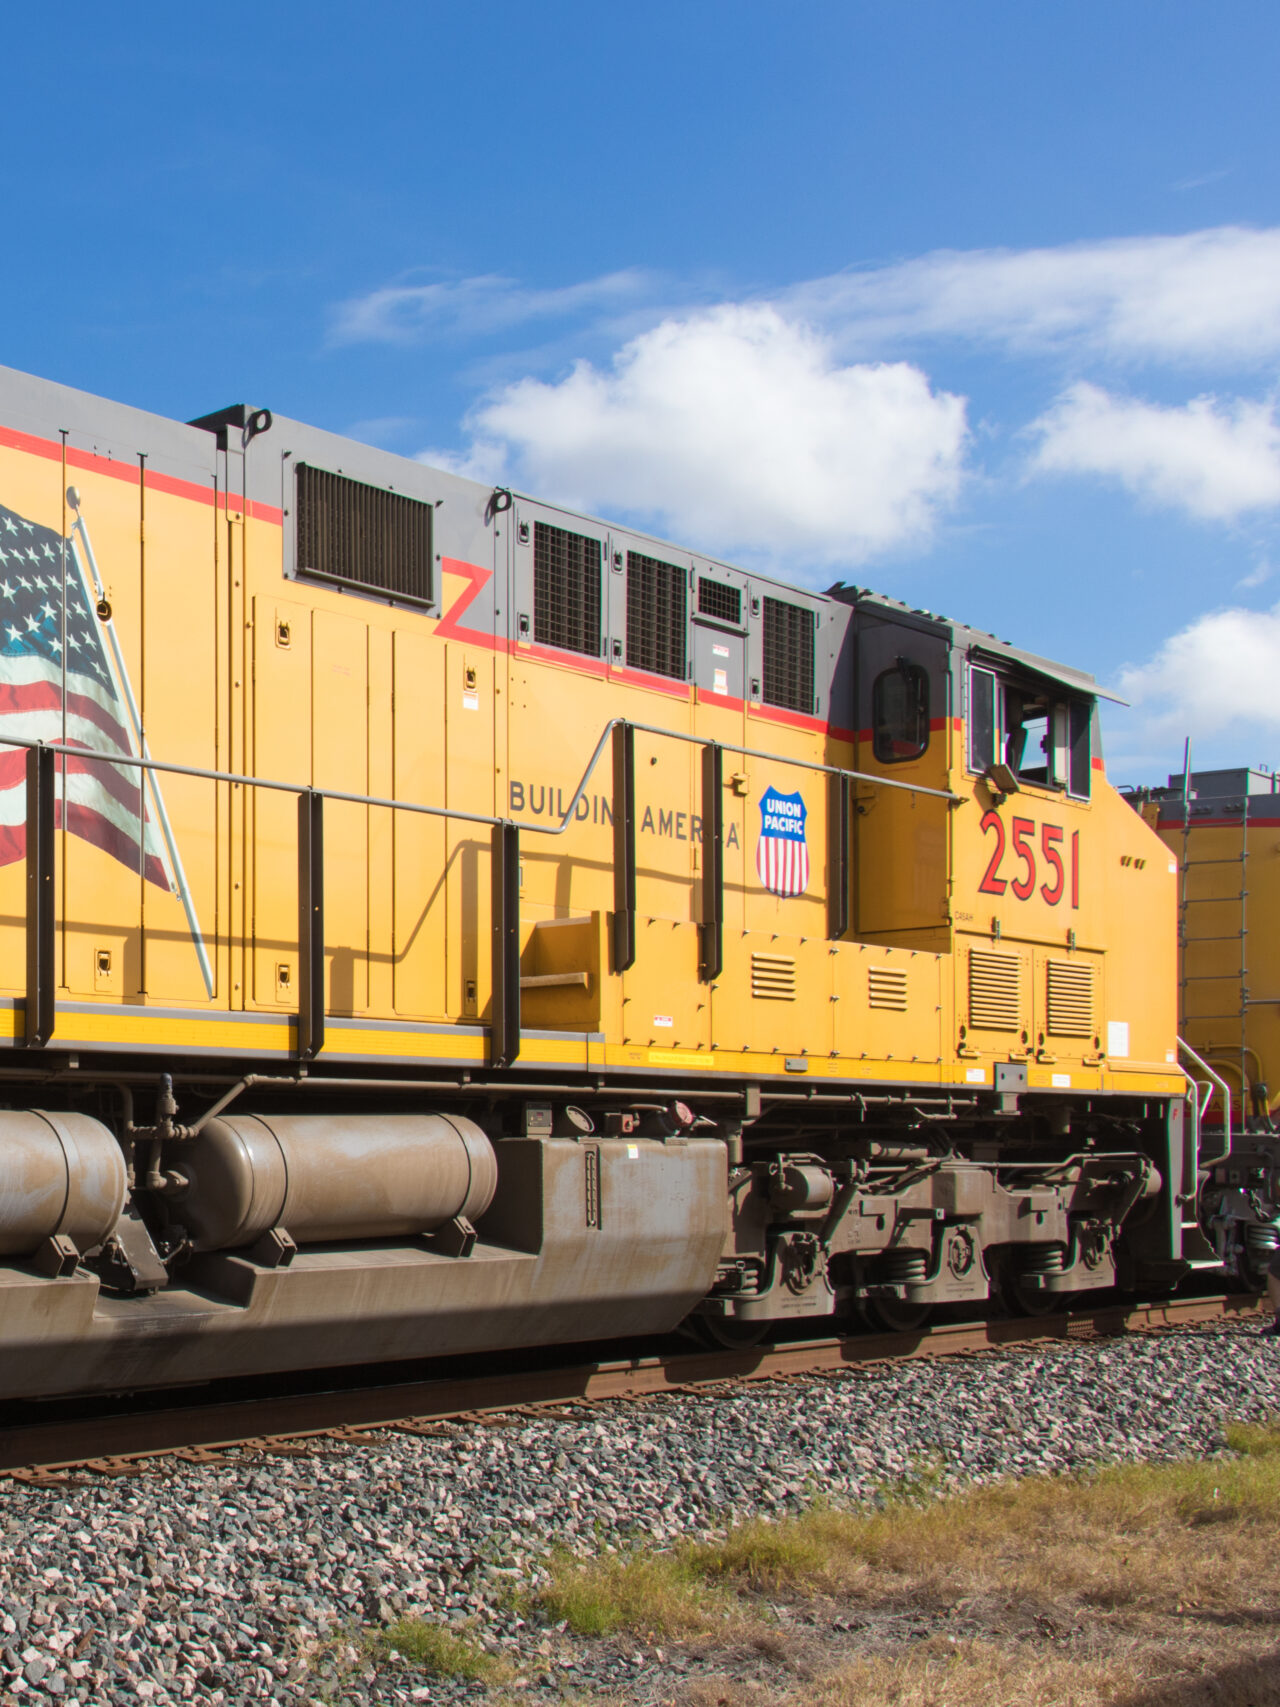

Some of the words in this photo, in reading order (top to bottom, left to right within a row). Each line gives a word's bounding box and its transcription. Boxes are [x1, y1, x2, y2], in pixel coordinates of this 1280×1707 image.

[510, 780, 620, 830] BUILDIN
[641, 805, 739, 850] AMERA
[764, 815, 803, 835] PACIFIC
[766, 798, 802, 818] UNION
[977, 809, 1080, 910] 2551
